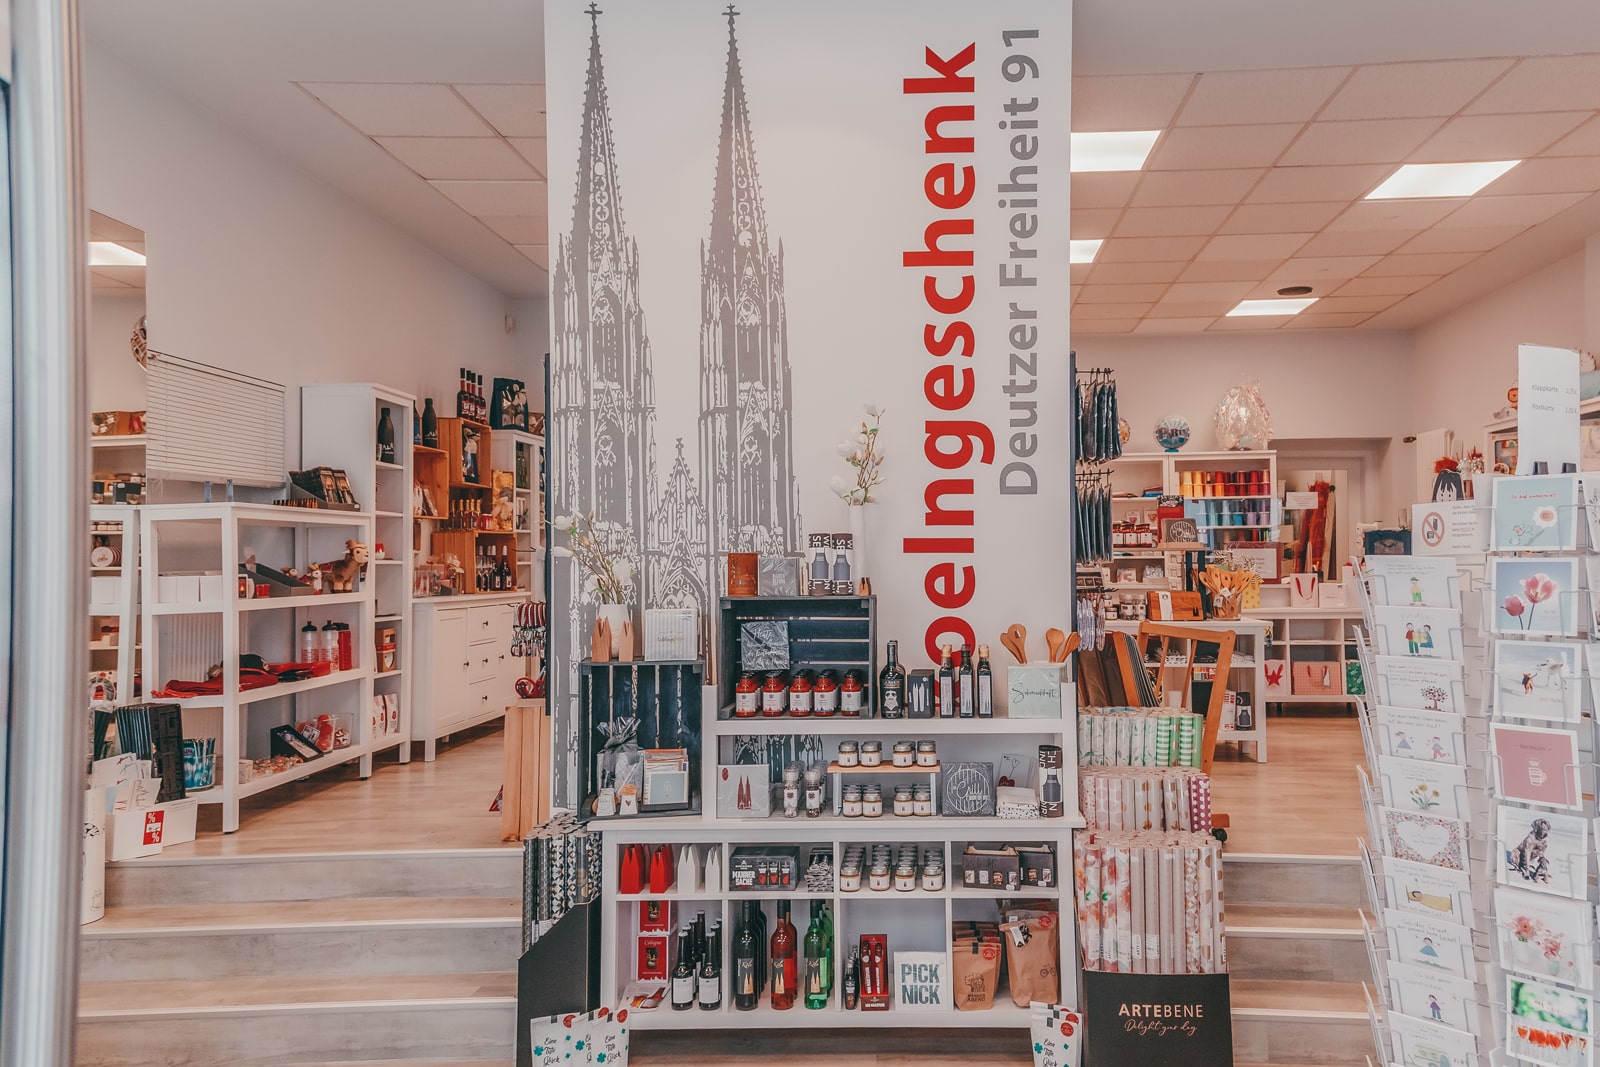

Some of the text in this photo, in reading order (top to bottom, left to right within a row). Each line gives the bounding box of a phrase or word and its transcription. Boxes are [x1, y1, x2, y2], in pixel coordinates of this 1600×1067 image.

[997, 29, 1040, 495] Deutzer Freiheit 91
[901, 963, 941, 984] PICK
[901, 985, 941, 1005] NICK
[1118, 1003, 1204, 1018] ARTEBENE
[1124, 1018, 1162, 1036] Delight
